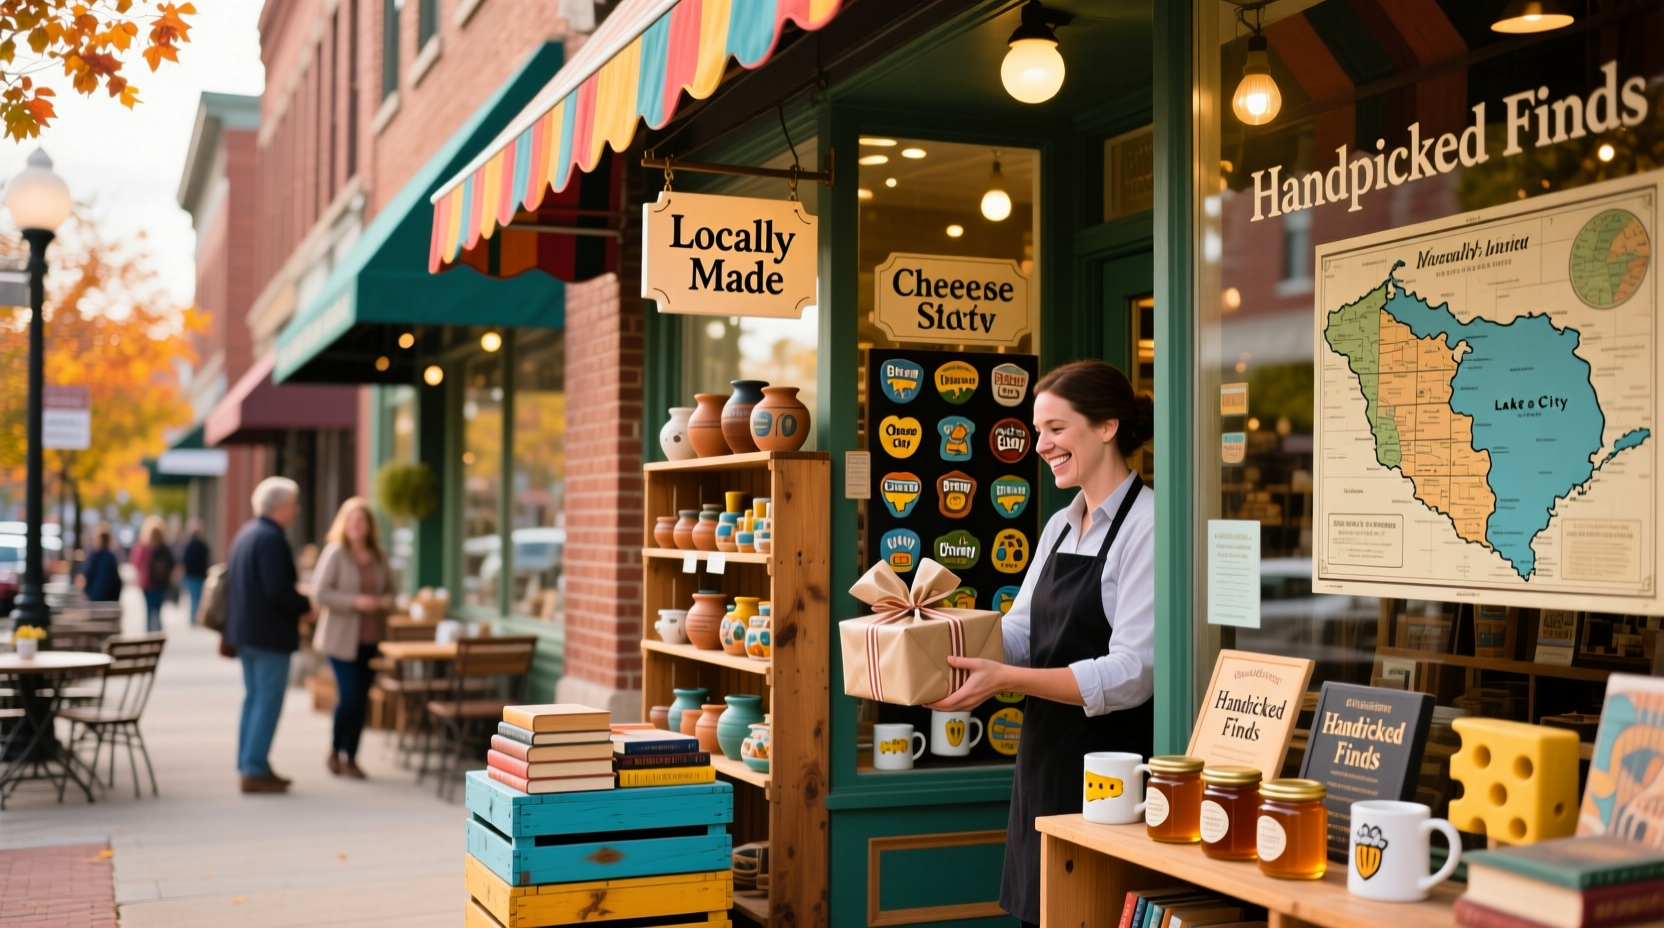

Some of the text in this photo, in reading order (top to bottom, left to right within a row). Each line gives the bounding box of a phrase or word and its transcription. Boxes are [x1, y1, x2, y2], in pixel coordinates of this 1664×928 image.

[1250, 60, 1649, 223] Handpicked Finds
[669, 214, 796, 264] Locally
[688, 257, 784, 295] Made
[1221, 717, 1260, 741] Finds
[1333, 740, 1381, 770] Finds
